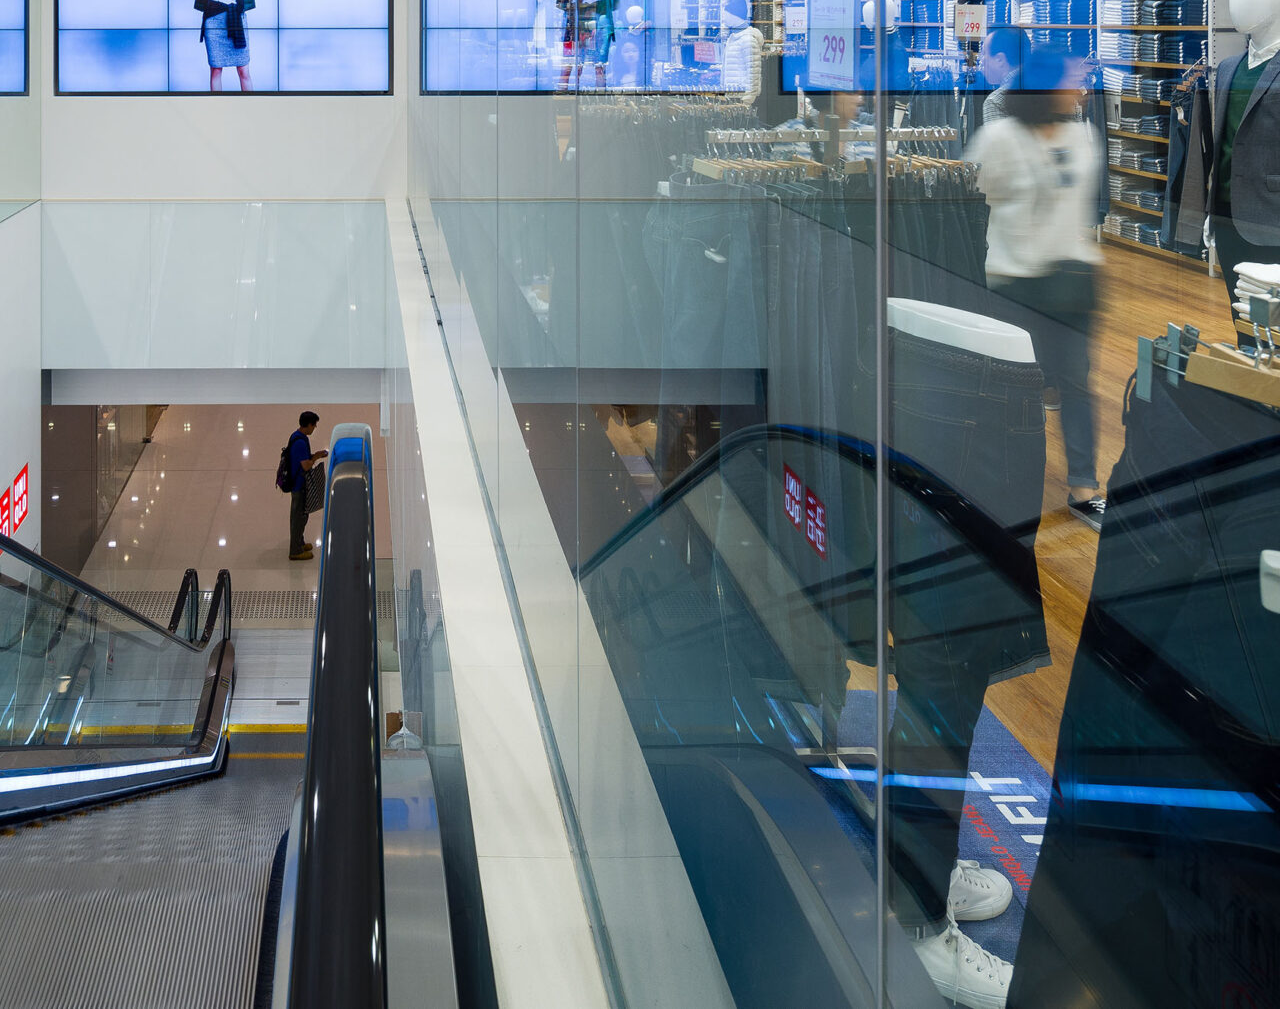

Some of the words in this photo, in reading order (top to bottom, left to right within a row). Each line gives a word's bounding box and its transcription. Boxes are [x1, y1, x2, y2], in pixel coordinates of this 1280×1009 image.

[14, 473, 26, 502] UNI
[14, 493, 27, 525] QLO
[969, 771, 1048, 825] FIT
[962, 804, 1000, 842] JEANS
[990, 846, 1032, 891] UNIQLO
